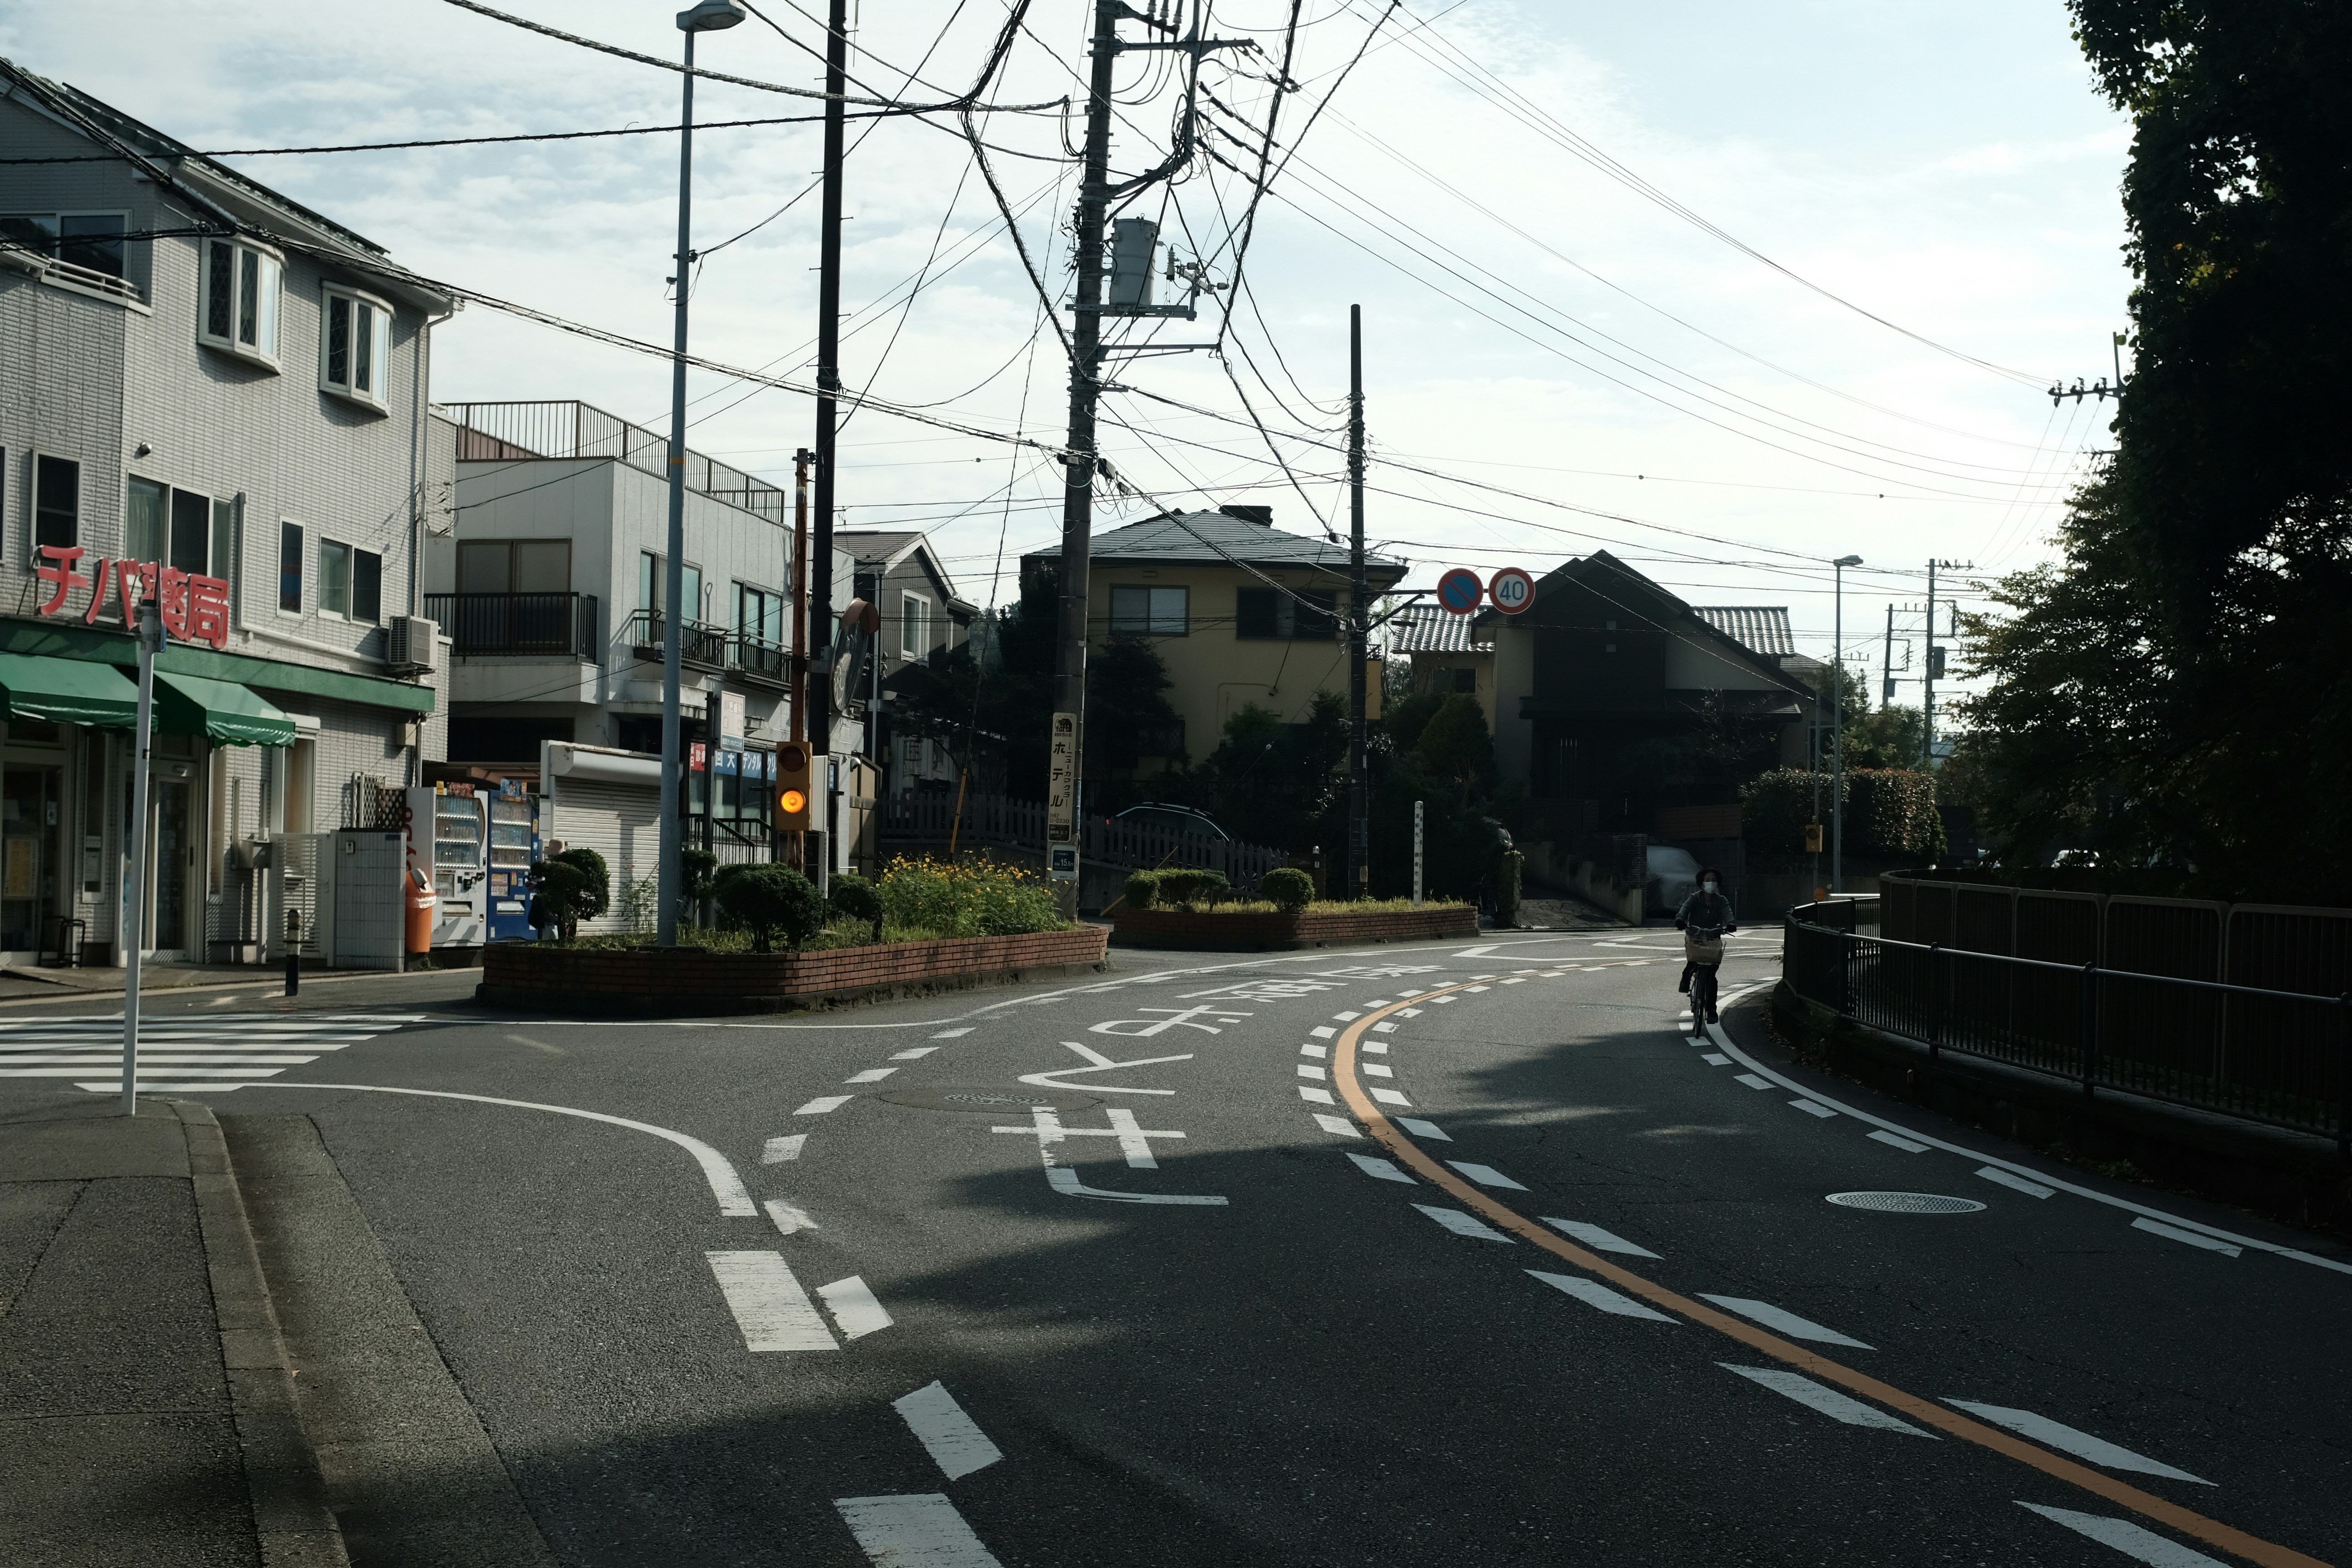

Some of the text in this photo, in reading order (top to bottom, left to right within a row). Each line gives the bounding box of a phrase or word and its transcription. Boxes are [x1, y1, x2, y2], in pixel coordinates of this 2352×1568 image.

[38, 544, 229, 649] チバ薬局
[1500, 581, 1525, 601] 40
[1050, 742, 1066, 807] ホテル
[991, 963, 1448, 1206] 速度おとせ
